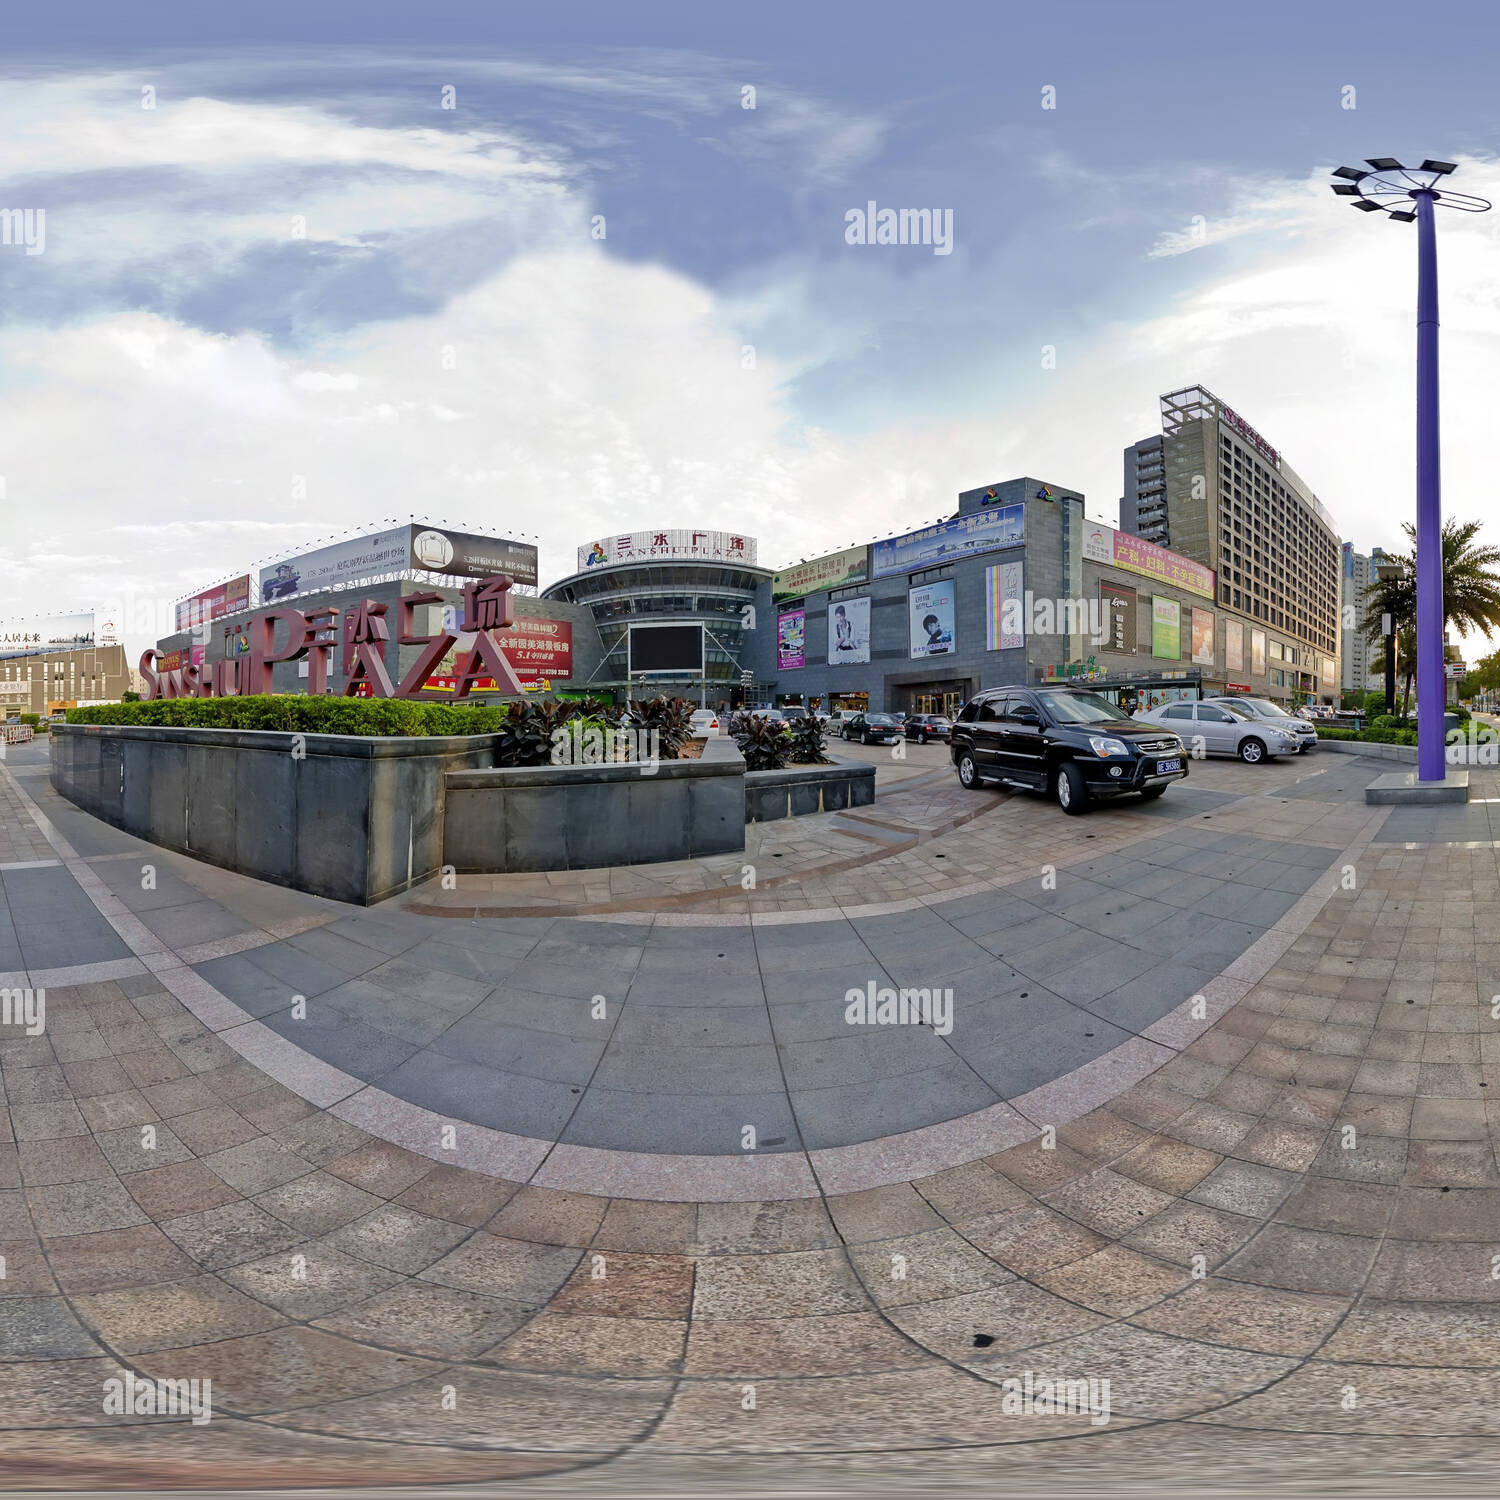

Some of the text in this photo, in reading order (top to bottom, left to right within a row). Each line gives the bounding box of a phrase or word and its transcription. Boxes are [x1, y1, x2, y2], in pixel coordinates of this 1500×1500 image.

[617, 533, 745, 551] 三水广场
[302, 576, 514, 649] 三水广场
[0, 632, 41, 643] 人居未来
[250, 609, 527, 701] PLAZA
